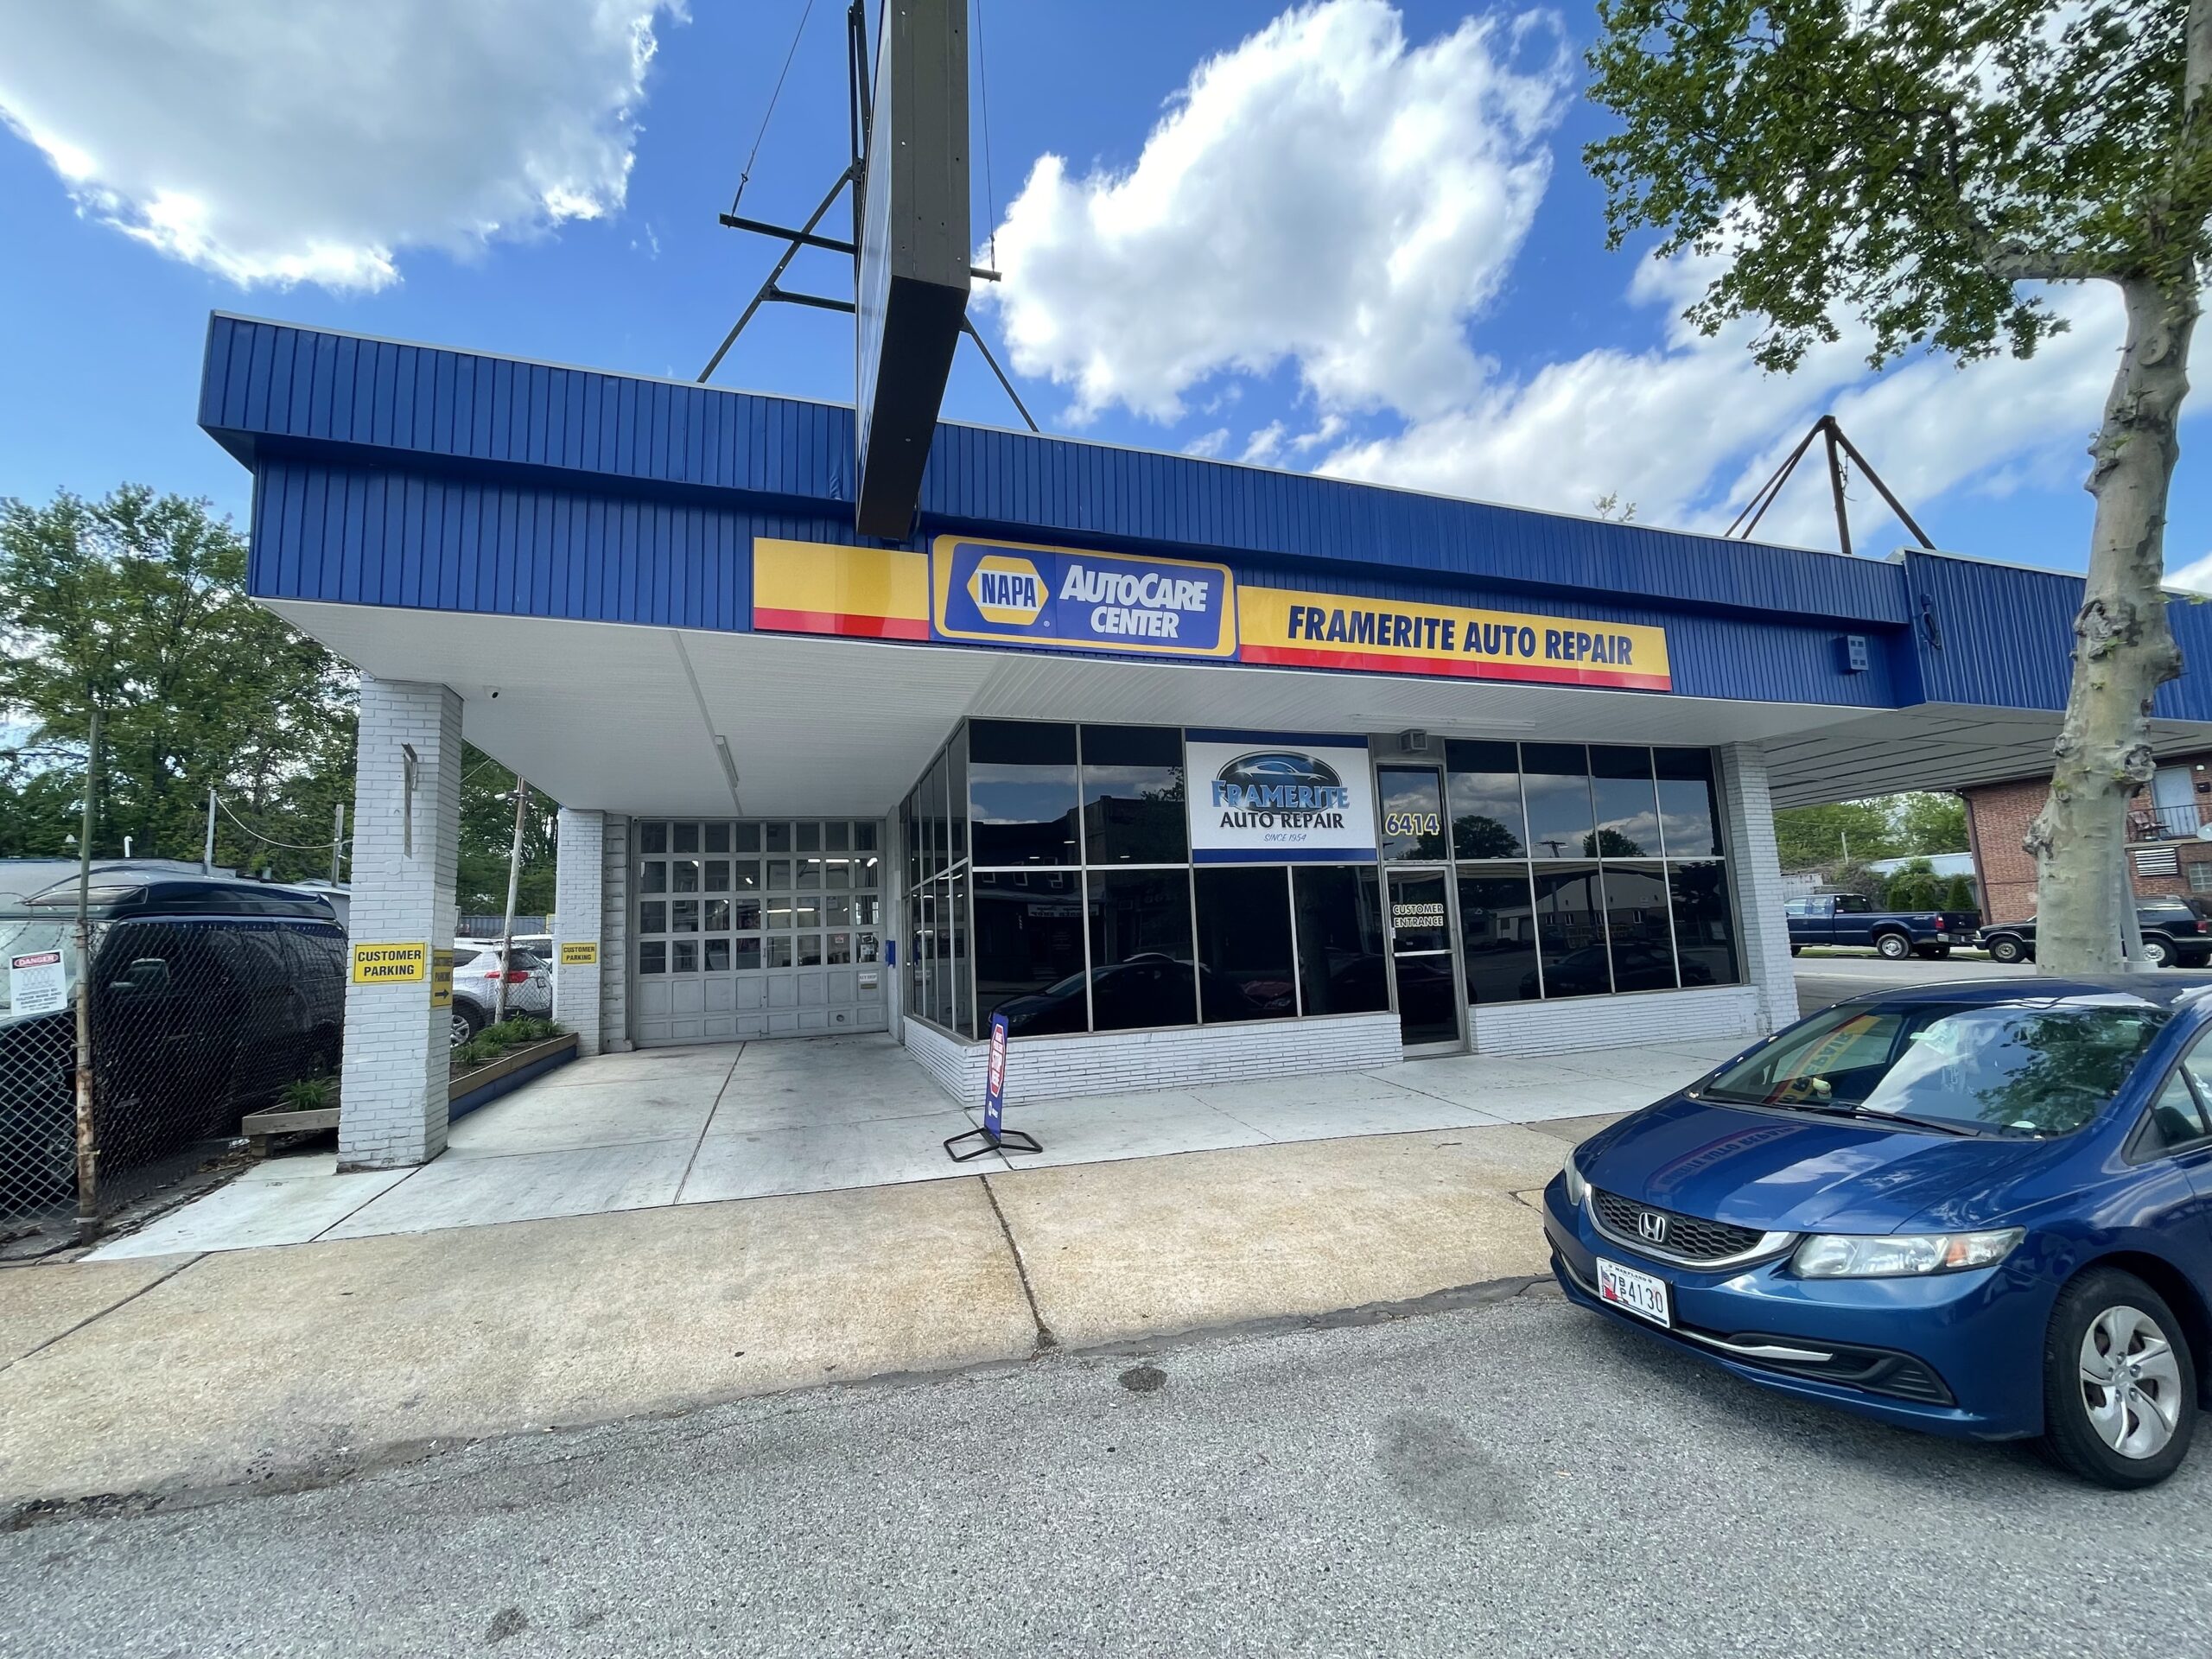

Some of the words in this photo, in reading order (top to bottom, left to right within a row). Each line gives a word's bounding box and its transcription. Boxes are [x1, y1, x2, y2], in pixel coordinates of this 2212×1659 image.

[982, 573, 1037, 608] NAPA
[1090, 606, 1180, 639] CENTER
[1287, 605, 1456, 651] FRAMERITE
[1463, 621, 1536, 658] AUTO
[1545, 629, 1632, 665] REPAIR
[1211, 779, 1351, 809] FRAMERITE
[1219, 811, 1274, 829] AUTO
[1281, 812, 1344, 829] REPAIR
[1385, 813, 1440, 836] 6414
[1263, 833, 1287, 842] SINCE
[1288, 833, 1307, 842] 1954
[1392, 903, 1445, 916] CUSTOMER
[1393, 916, 1444, 928] ENTRANCE
[18, 955, 54, 966] DANGER
[358, 950, 422, 962] CUSTOMER
[363, 964, 415, 976] PARKING
[1614, 1267, 1647, 1282] MARYLAND
